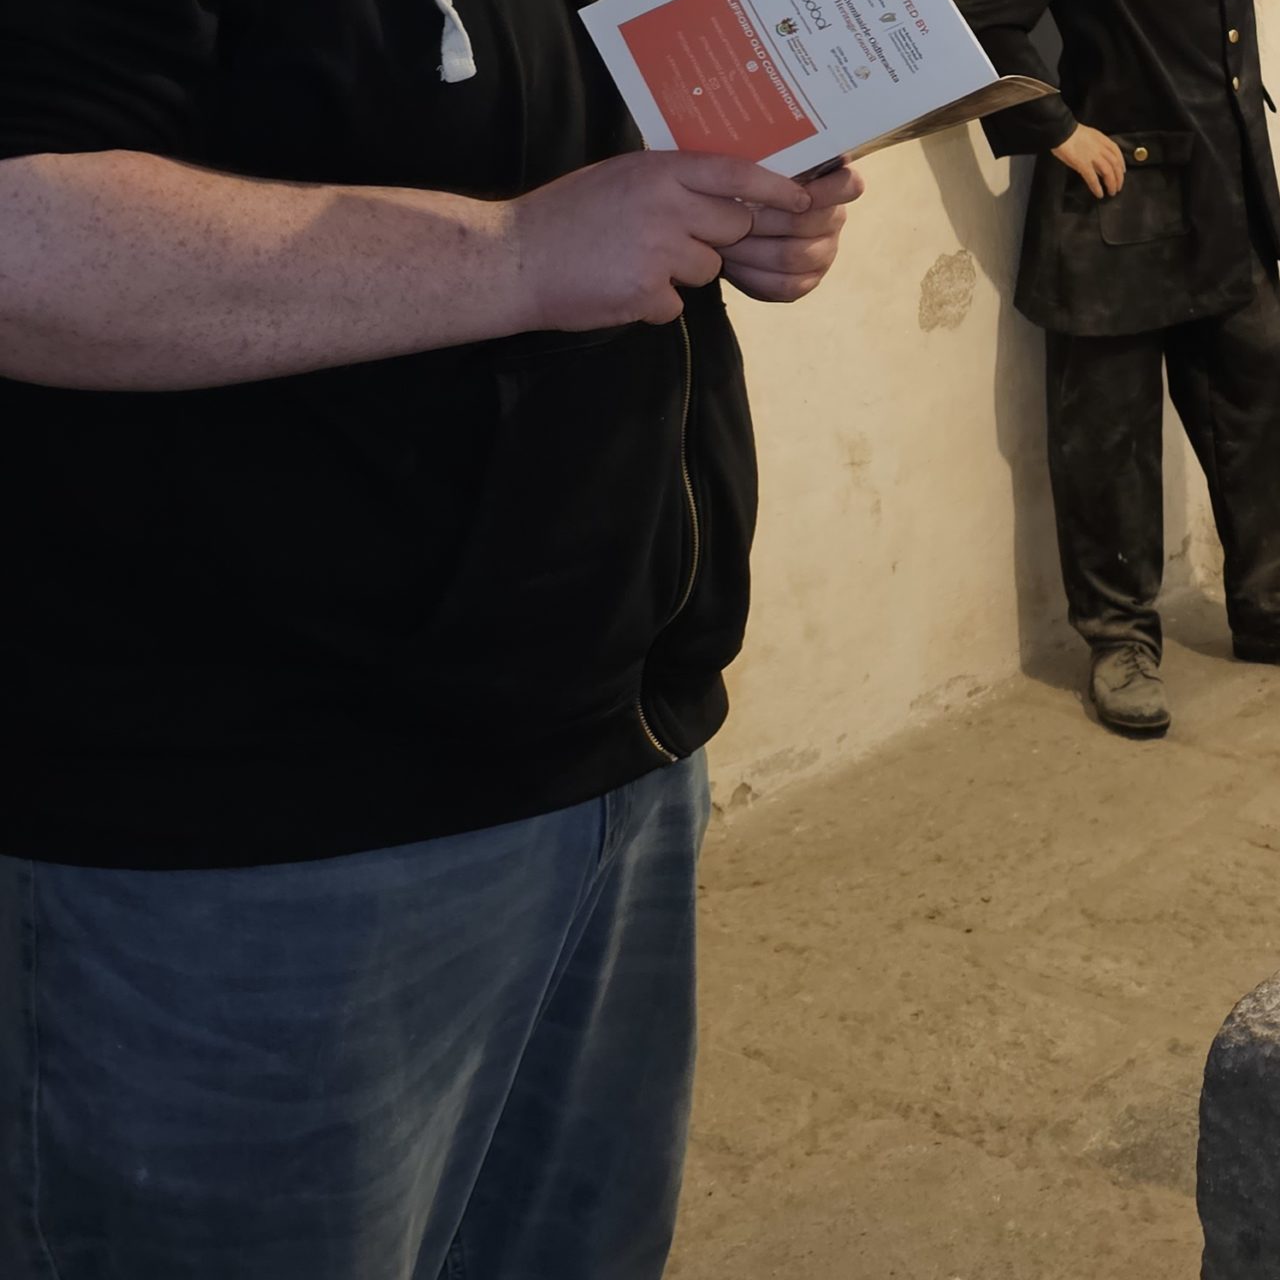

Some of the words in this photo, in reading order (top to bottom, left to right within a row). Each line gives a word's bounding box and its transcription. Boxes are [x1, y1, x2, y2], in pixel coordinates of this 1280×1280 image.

[914, 18, 930, 35] BY:
[853, 31, 877, 63] Council
[867, 36, 901, 83] Oidhreachta
[748, 37, 768, 60] OLD
[760, 58, 804, 121] COURTHOUSE
